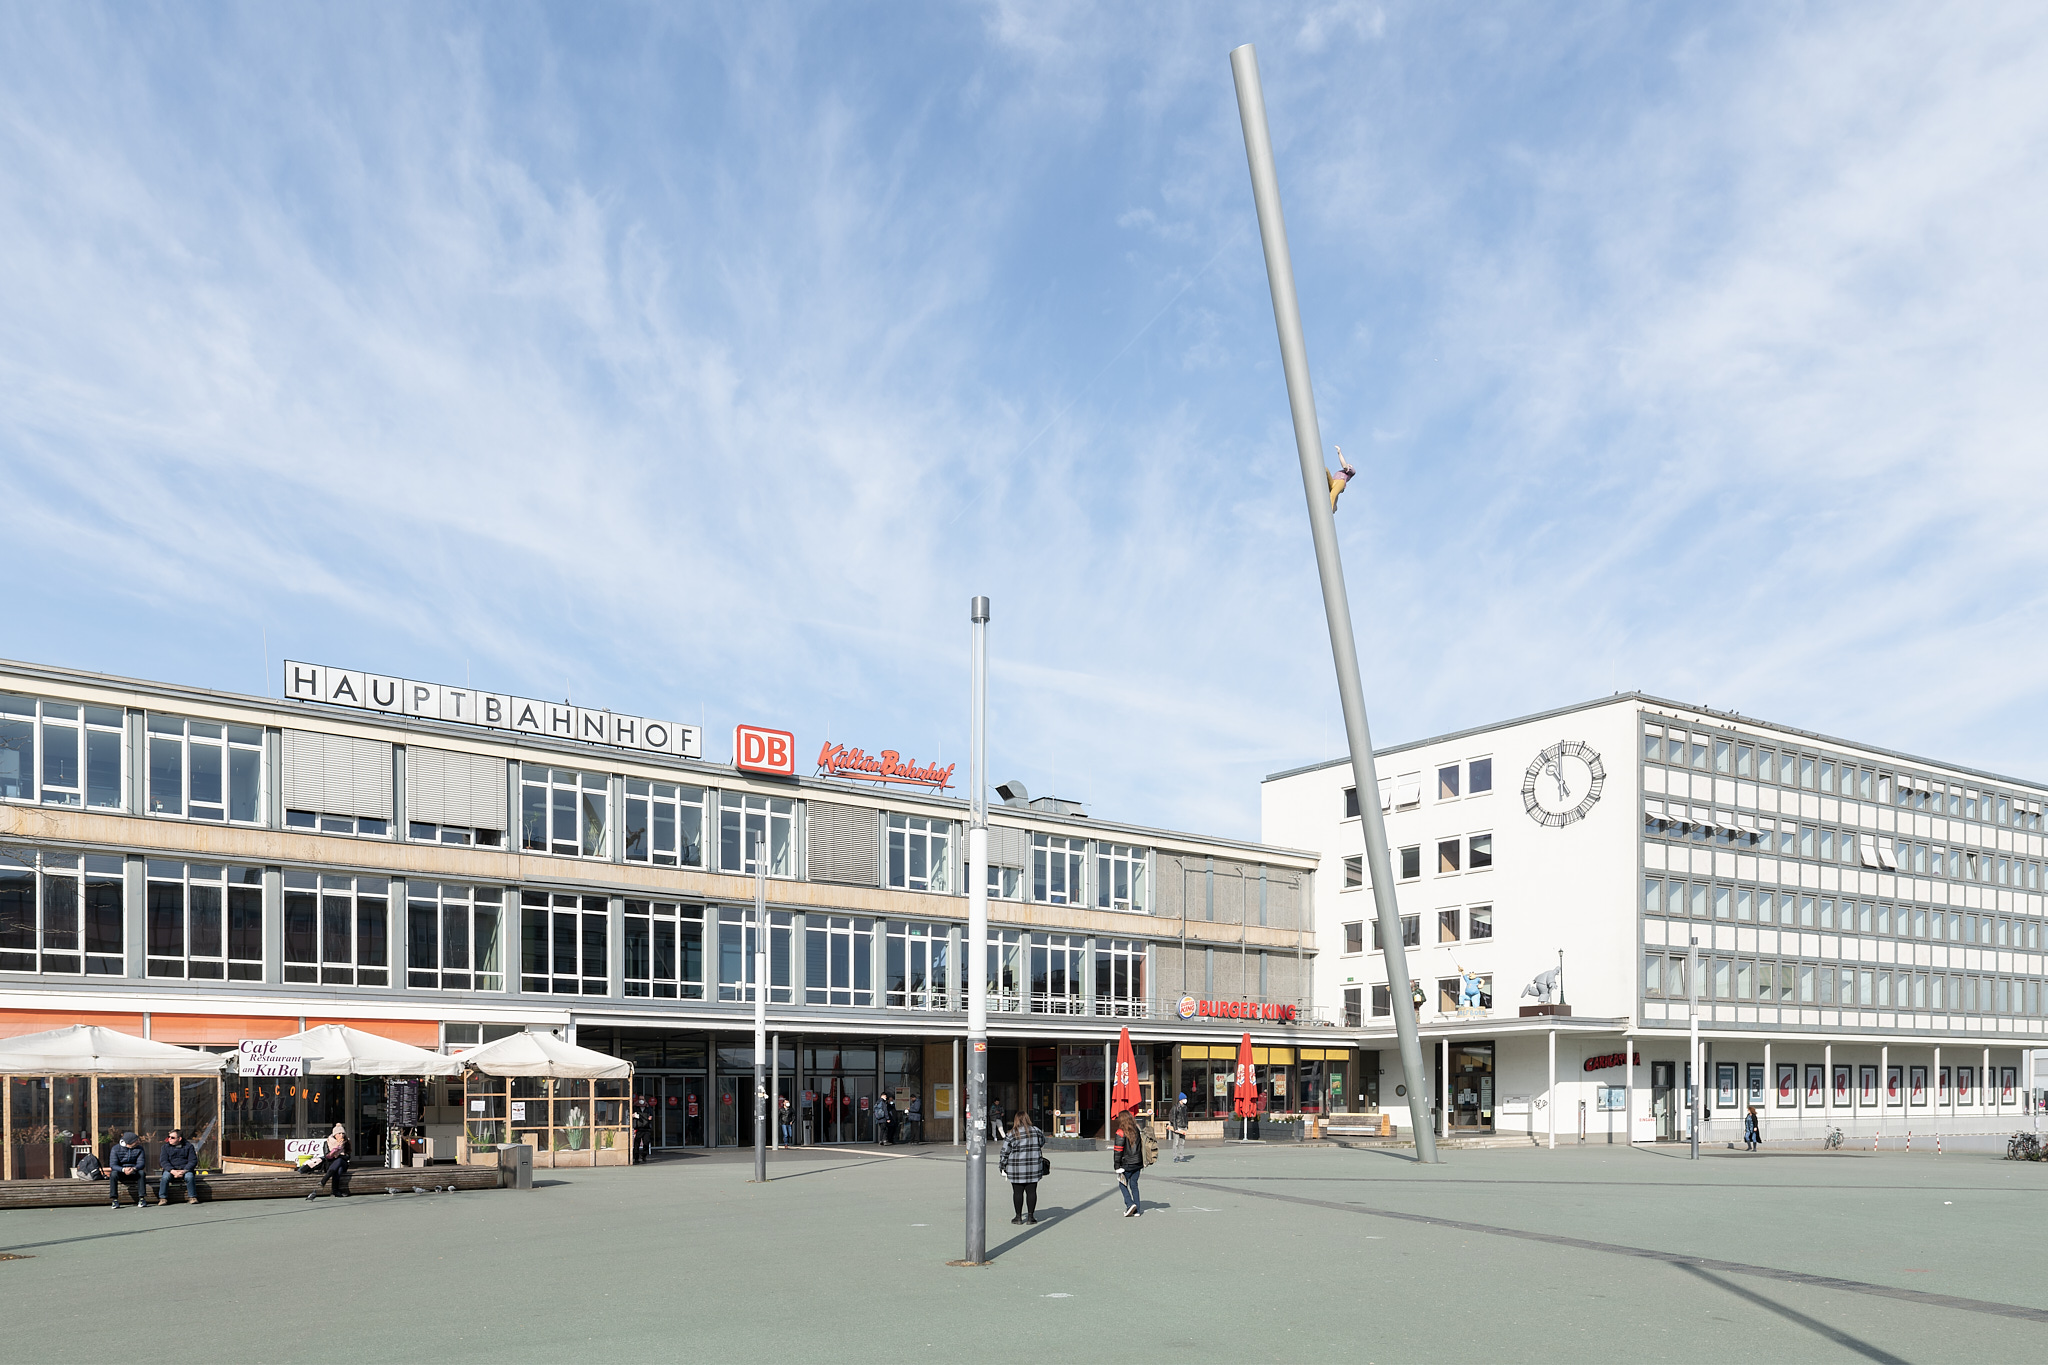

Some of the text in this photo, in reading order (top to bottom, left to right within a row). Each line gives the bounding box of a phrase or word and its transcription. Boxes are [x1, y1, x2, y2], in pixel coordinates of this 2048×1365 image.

[294, 666, 693, 752] HAUPTBAHNHOF
[744, 732, 788, 767] DB
[1198, 1000, 1296, 1020] BURGER KING
[240, 1041, 277, 1056] Cafe
[249, 1054, 301, 1062] Restaurant
[1584, 1052, 1640, 1071] CARICATA
[255, 1064, 299, 1076] KuBa
[230, 1085, 320, 1103] WELCOME
[1780, 1073, 2012, 1098] CARICATUA
[287, 1140, 320, 1155] Cafe
